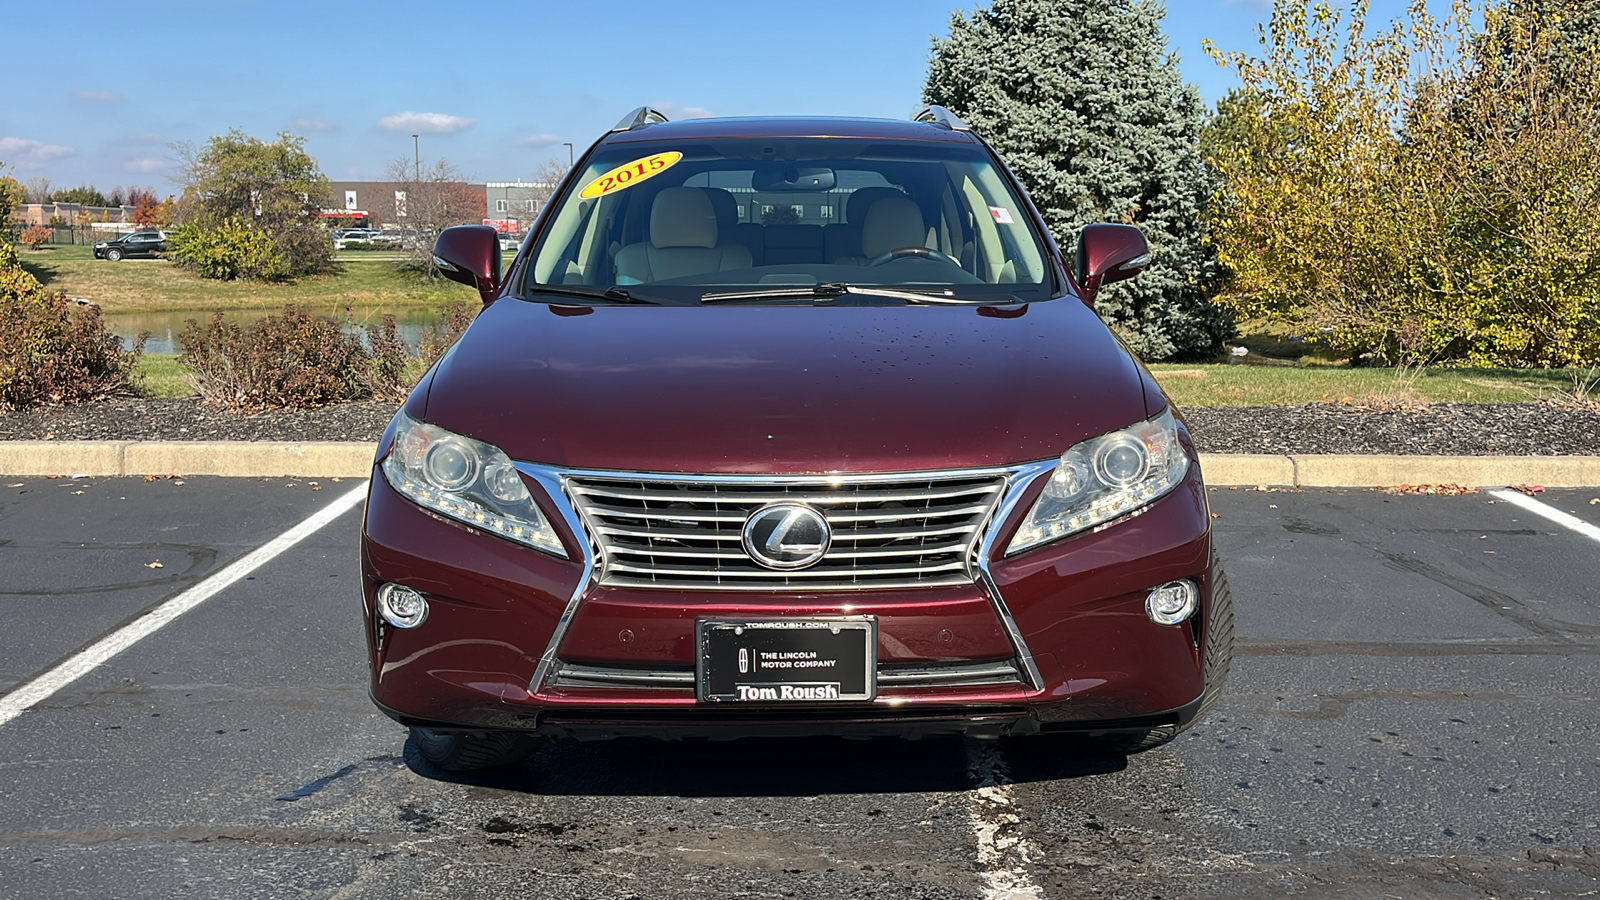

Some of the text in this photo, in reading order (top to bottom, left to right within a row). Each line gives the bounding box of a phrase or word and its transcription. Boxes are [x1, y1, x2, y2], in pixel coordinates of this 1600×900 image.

[599, 156, 665, 192] 2015
[778, 651, 817, 659] LINCOLN
[761, 660, 836, 669] MOTOR COMPANY
[737, 684, 838, 700] Tom Roush
